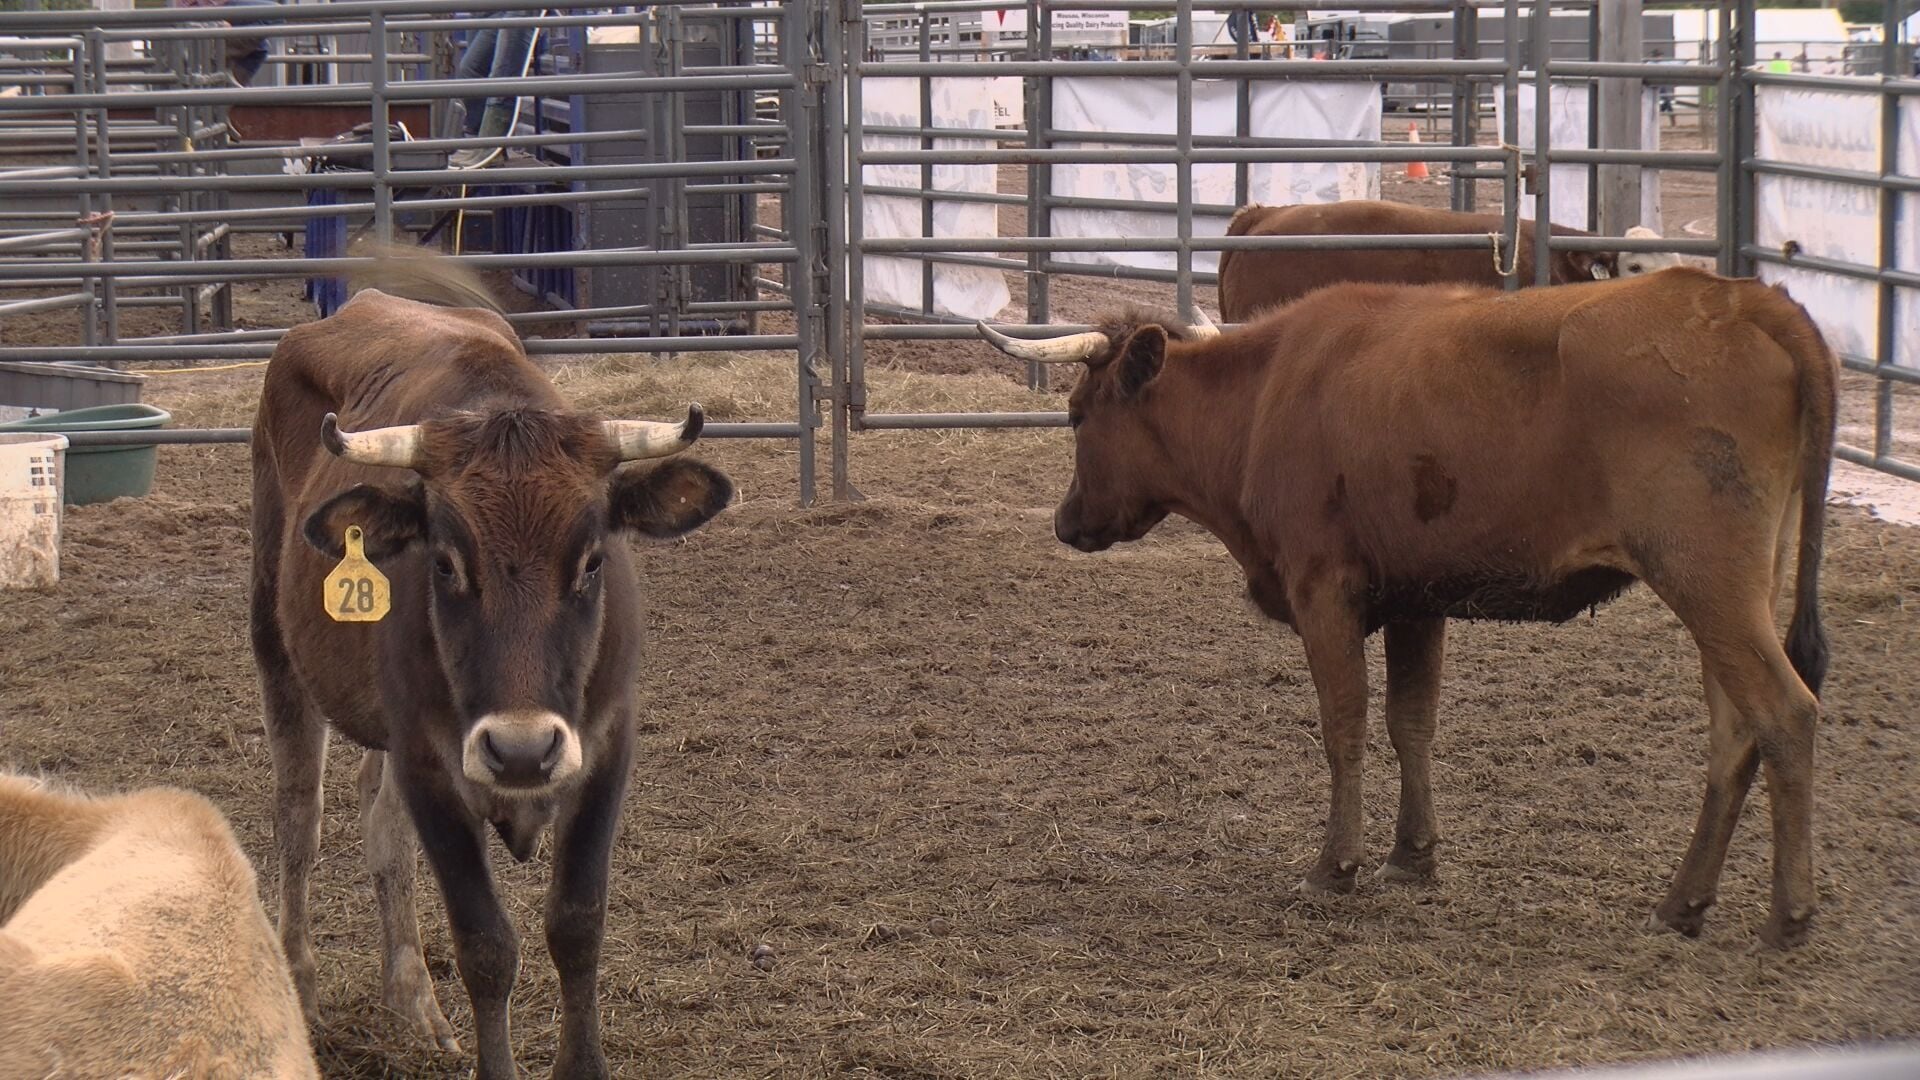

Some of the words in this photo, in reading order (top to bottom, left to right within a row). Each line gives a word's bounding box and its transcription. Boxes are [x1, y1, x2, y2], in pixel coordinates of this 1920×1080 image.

[1066, 21, 1084, 29] Quality
[1085, 21, 1099, 29] Dairy
[338, 577, 374, 613] 28
